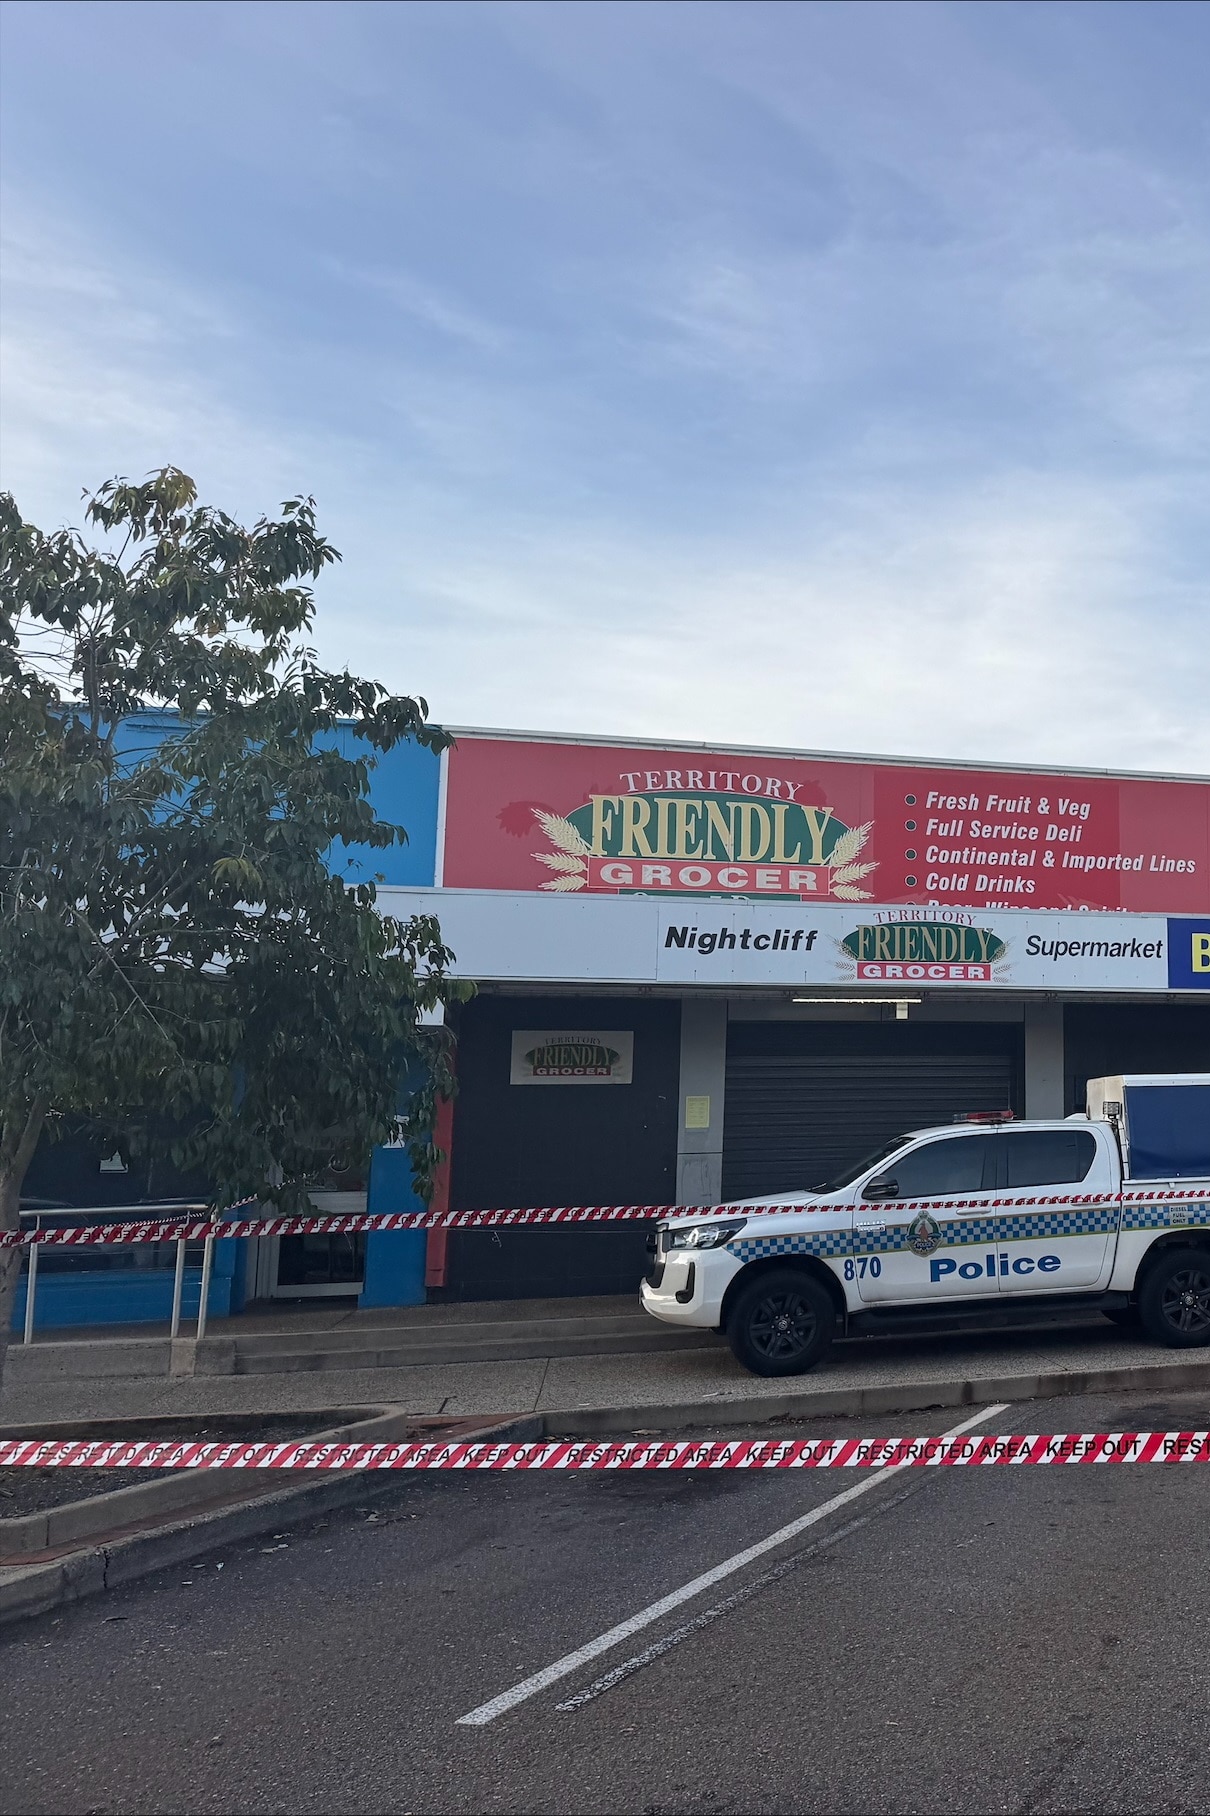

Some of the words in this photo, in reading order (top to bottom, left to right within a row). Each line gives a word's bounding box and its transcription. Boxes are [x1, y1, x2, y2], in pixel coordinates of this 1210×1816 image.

[620, 769, 803, 801] TERRITORY
[926, 791, 980, 810] Fresh
[986, 795, 1031, 814] Fruit
[1037, 798, 1050, 815] &
[1058, 799, 1091, 820] Veg
[589, 794, 833, 865] FRIENDLY
[926, 818, 963, 837] Full
[969, 821, 1039, 842] Service
[1046, 824, 1082, 842] Deli
[926, 845, 1036, 867] Continental
[1042, 851, 1055, 867] &
[1062, 852, 1143, 873] Imported
[1149, 855, 1196, 873] Lines
[600, 863, 818, 891] GROCER
[926, 873, 971, 892] Cold
[975, 875, 1035, 894] Drinks
[873, 909, 977, 926] TERRITORY
[664, 926, 817, 955] Nightcliff
[856, 924, 993, 962] FRIENDLY
[1026, 935, 1164, 961] Supermarket
[862, 963, 986, 979] GROCER
[545, 1036, 601, 1045] TERRITORY
[534, 1046, 611, 1066] FRIENDLY
[536, 1067, 608, 1075] GROCER
[843, 1256, 881, 1281] 870
[930, 1253, 1061, 1282] Police
[243, 1448, 279, 1461] OUT
[293, 1448, 400, 1462] RESTRICTED
[402, 1448, 450, 1462] AREA
[462, 1448, 509, 1462] KEEP
[512, 1448, 550, 1462] OUT
[566, 1447, 679, 1462] RESTRICTED
[683, 1447, 732, 1462] AREA
[746, 1447, 795, 1462] KEEP
[799, 1446, 837, 1461] OUT
[857, 1443, 973, 1460] RESTRICTED
[980, 1442, 1032, 1458] AREA
[1046, 1441, 1096, 1457] KEEP
[1101, 1441, 1141, 1456] OUT
